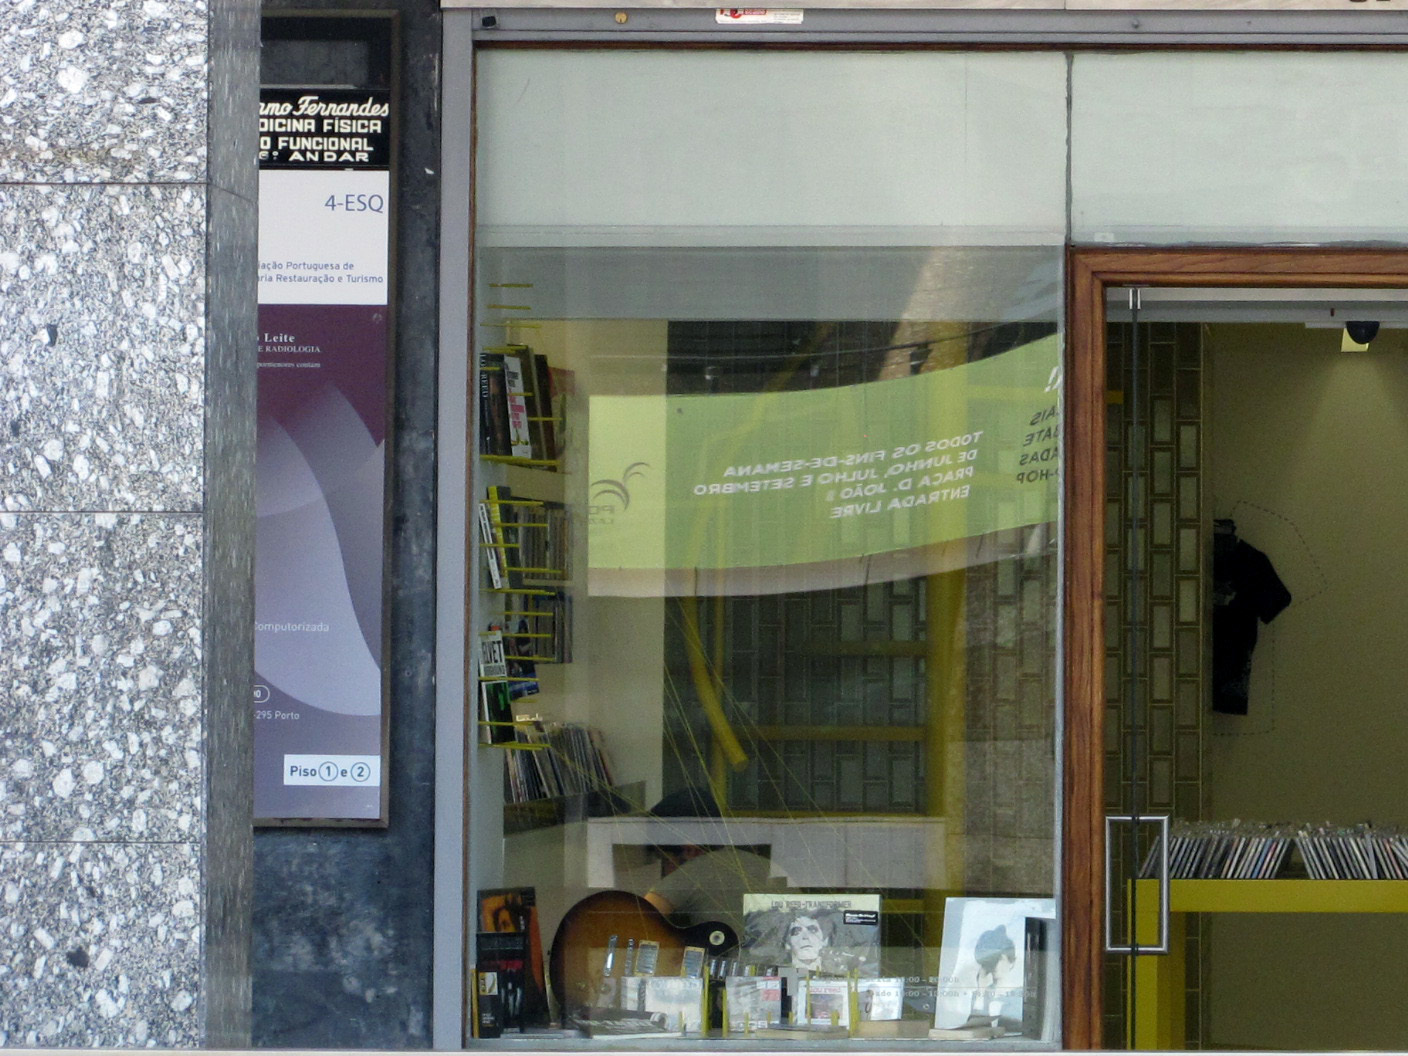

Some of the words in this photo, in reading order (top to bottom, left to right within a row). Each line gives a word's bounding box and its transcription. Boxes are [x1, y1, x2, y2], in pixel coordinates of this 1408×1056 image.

[292, 95, 390, 116] Fernandes
[259, 118, 315, 132] DICINA
[323, 116, 381, 133] FÍSICA
[278, 136, 374, 151] FUNCIONAL
[288, 150, 370, 162] ANDAR
[324, 194, 384, 214] 4-ESQ
[286, 261, 340, 272] Portuguesa
[343, 261, 355, 271] de
[276, 273, 335, 285] Restauração
[338, 275, 344, 283] e
[346, 273, 384, 283] Turismo
[264, 332, 296, 343] Leite
[266, 345, 321, 353] RADIOLOGIA
[274, 710, 300, 720] Porto
[290, 765, 317, 777] Piso
[340, 769, 348, 777] e
